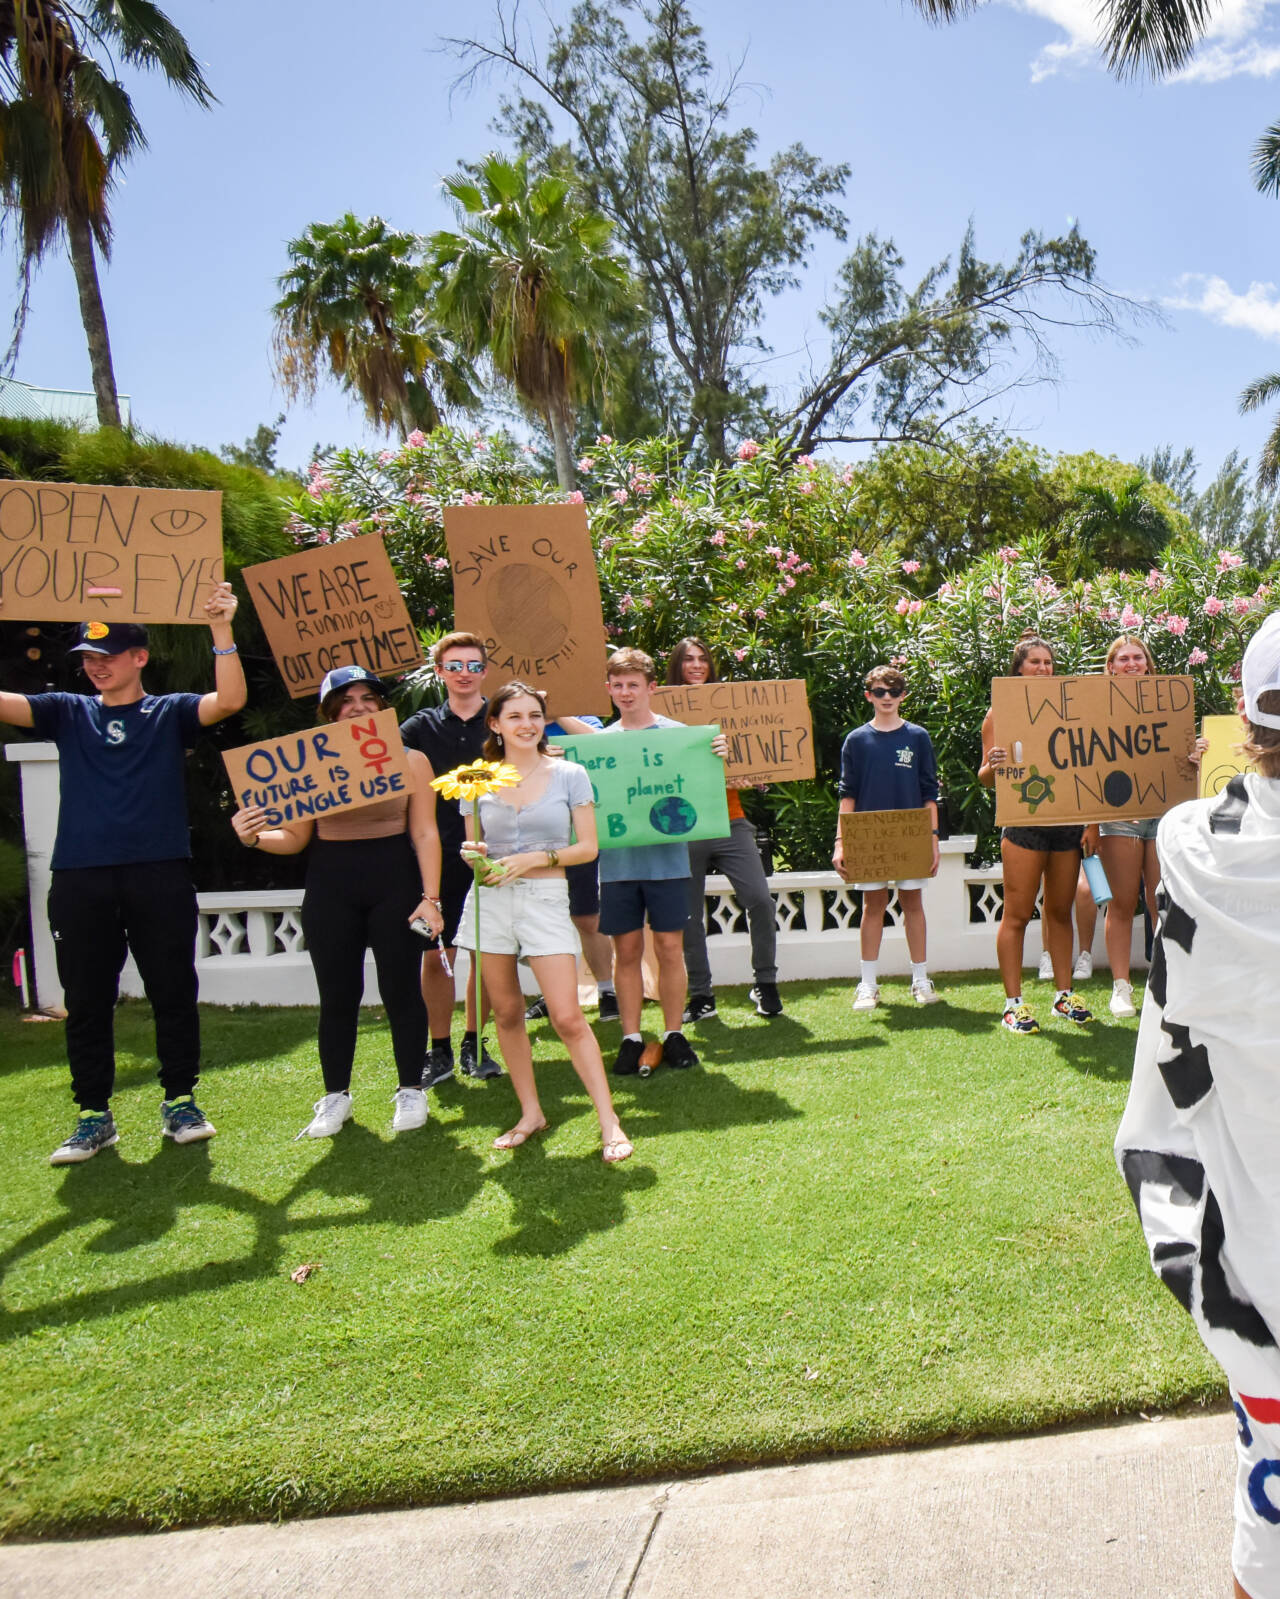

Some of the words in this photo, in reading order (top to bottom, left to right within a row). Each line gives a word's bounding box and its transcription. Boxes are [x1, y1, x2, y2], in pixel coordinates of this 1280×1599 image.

[0, 487, 139, 547] OPEN
[0, 545, 120, 608] YOUR
[454, 535, 510, 585] SAVE
[532, 538, 578, 579] OUR
[258, 573, 318, 619] WE
[319, 561, 378, 610] ARE
[283, 652, 316, 684] OUT
[341, 624, 421, 671] TIME!
[654, 688, 702, 716] THE
[710, 684, 793, 710] CLIMATE
[1025, 680, 1080, 725] WE
[1109, 679, 1191, 716] NEED
[246, 733, 340, 783] OUR
[351, 718, 392, 774] NOT
[642, 747, 663, 767] is
[756, 727, 807, 766] WE?
[1049, 722, 1170, 770] CHANGE
[241, 774, 318, 808] FUTURE
[328, 765, 349, 783] IS
[264, 784, 352, 826] SINGLE
[360, 772, 405, 798] USE
[627, 774, 685, 805] planet
[607, 813, 628, 838] B
